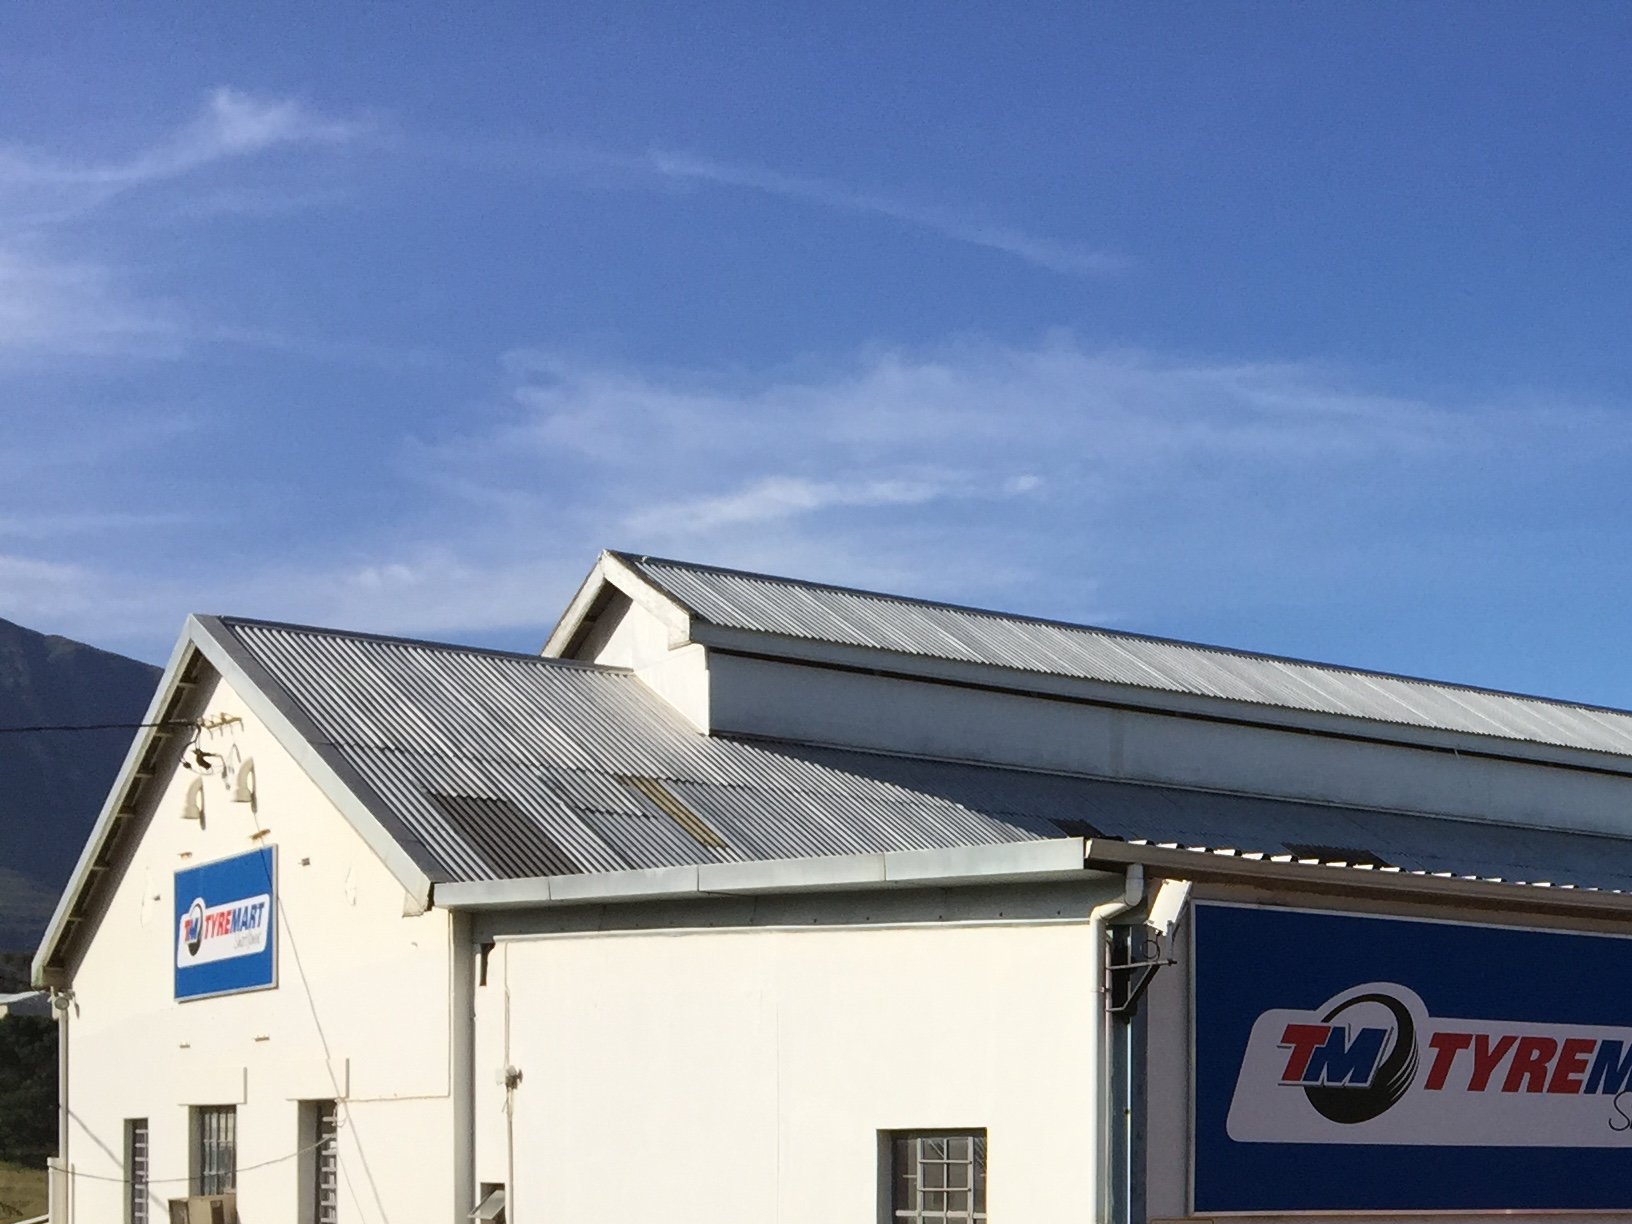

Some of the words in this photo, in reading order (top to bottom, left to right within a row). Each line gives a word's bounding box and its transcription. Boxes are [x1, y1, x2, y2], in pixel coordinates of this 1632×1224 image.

[184, 917, 200, 942] TM
[204, 901, 265, 940] TYREMART
[1279, 1023, 1390, 1086] TM
